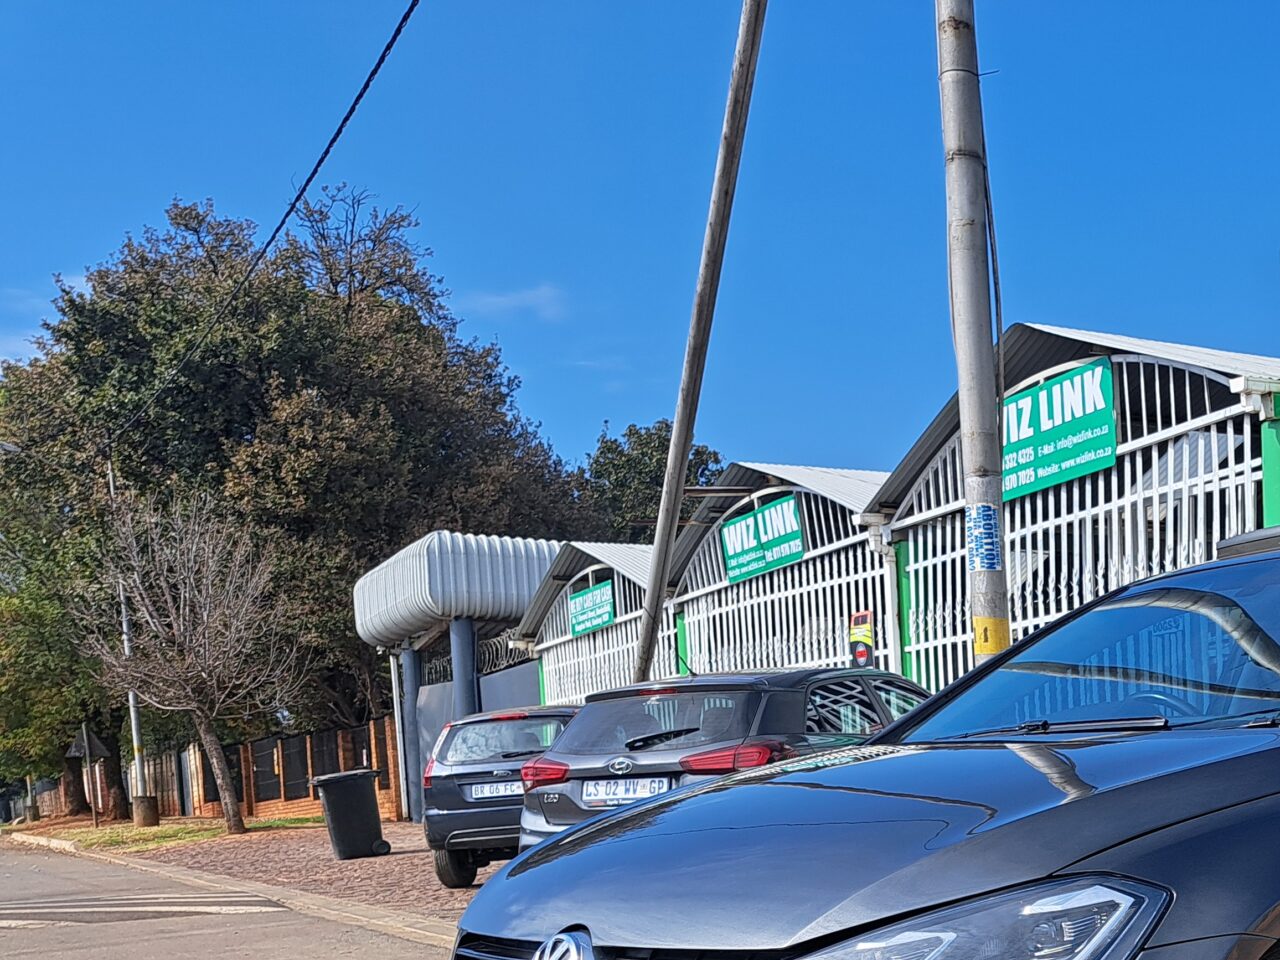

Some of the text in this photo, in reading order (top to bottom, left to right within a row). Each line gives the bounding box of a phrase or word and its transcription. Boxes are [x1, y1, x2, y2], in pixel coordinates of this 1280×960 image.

[1039, 366, 1106, 432] LINK
[723, 499, 800, 556] WIZ LINK
[981, 505, 997, 570] ABORTION
[585, 779, 664, 797] LS 02 WV GP
